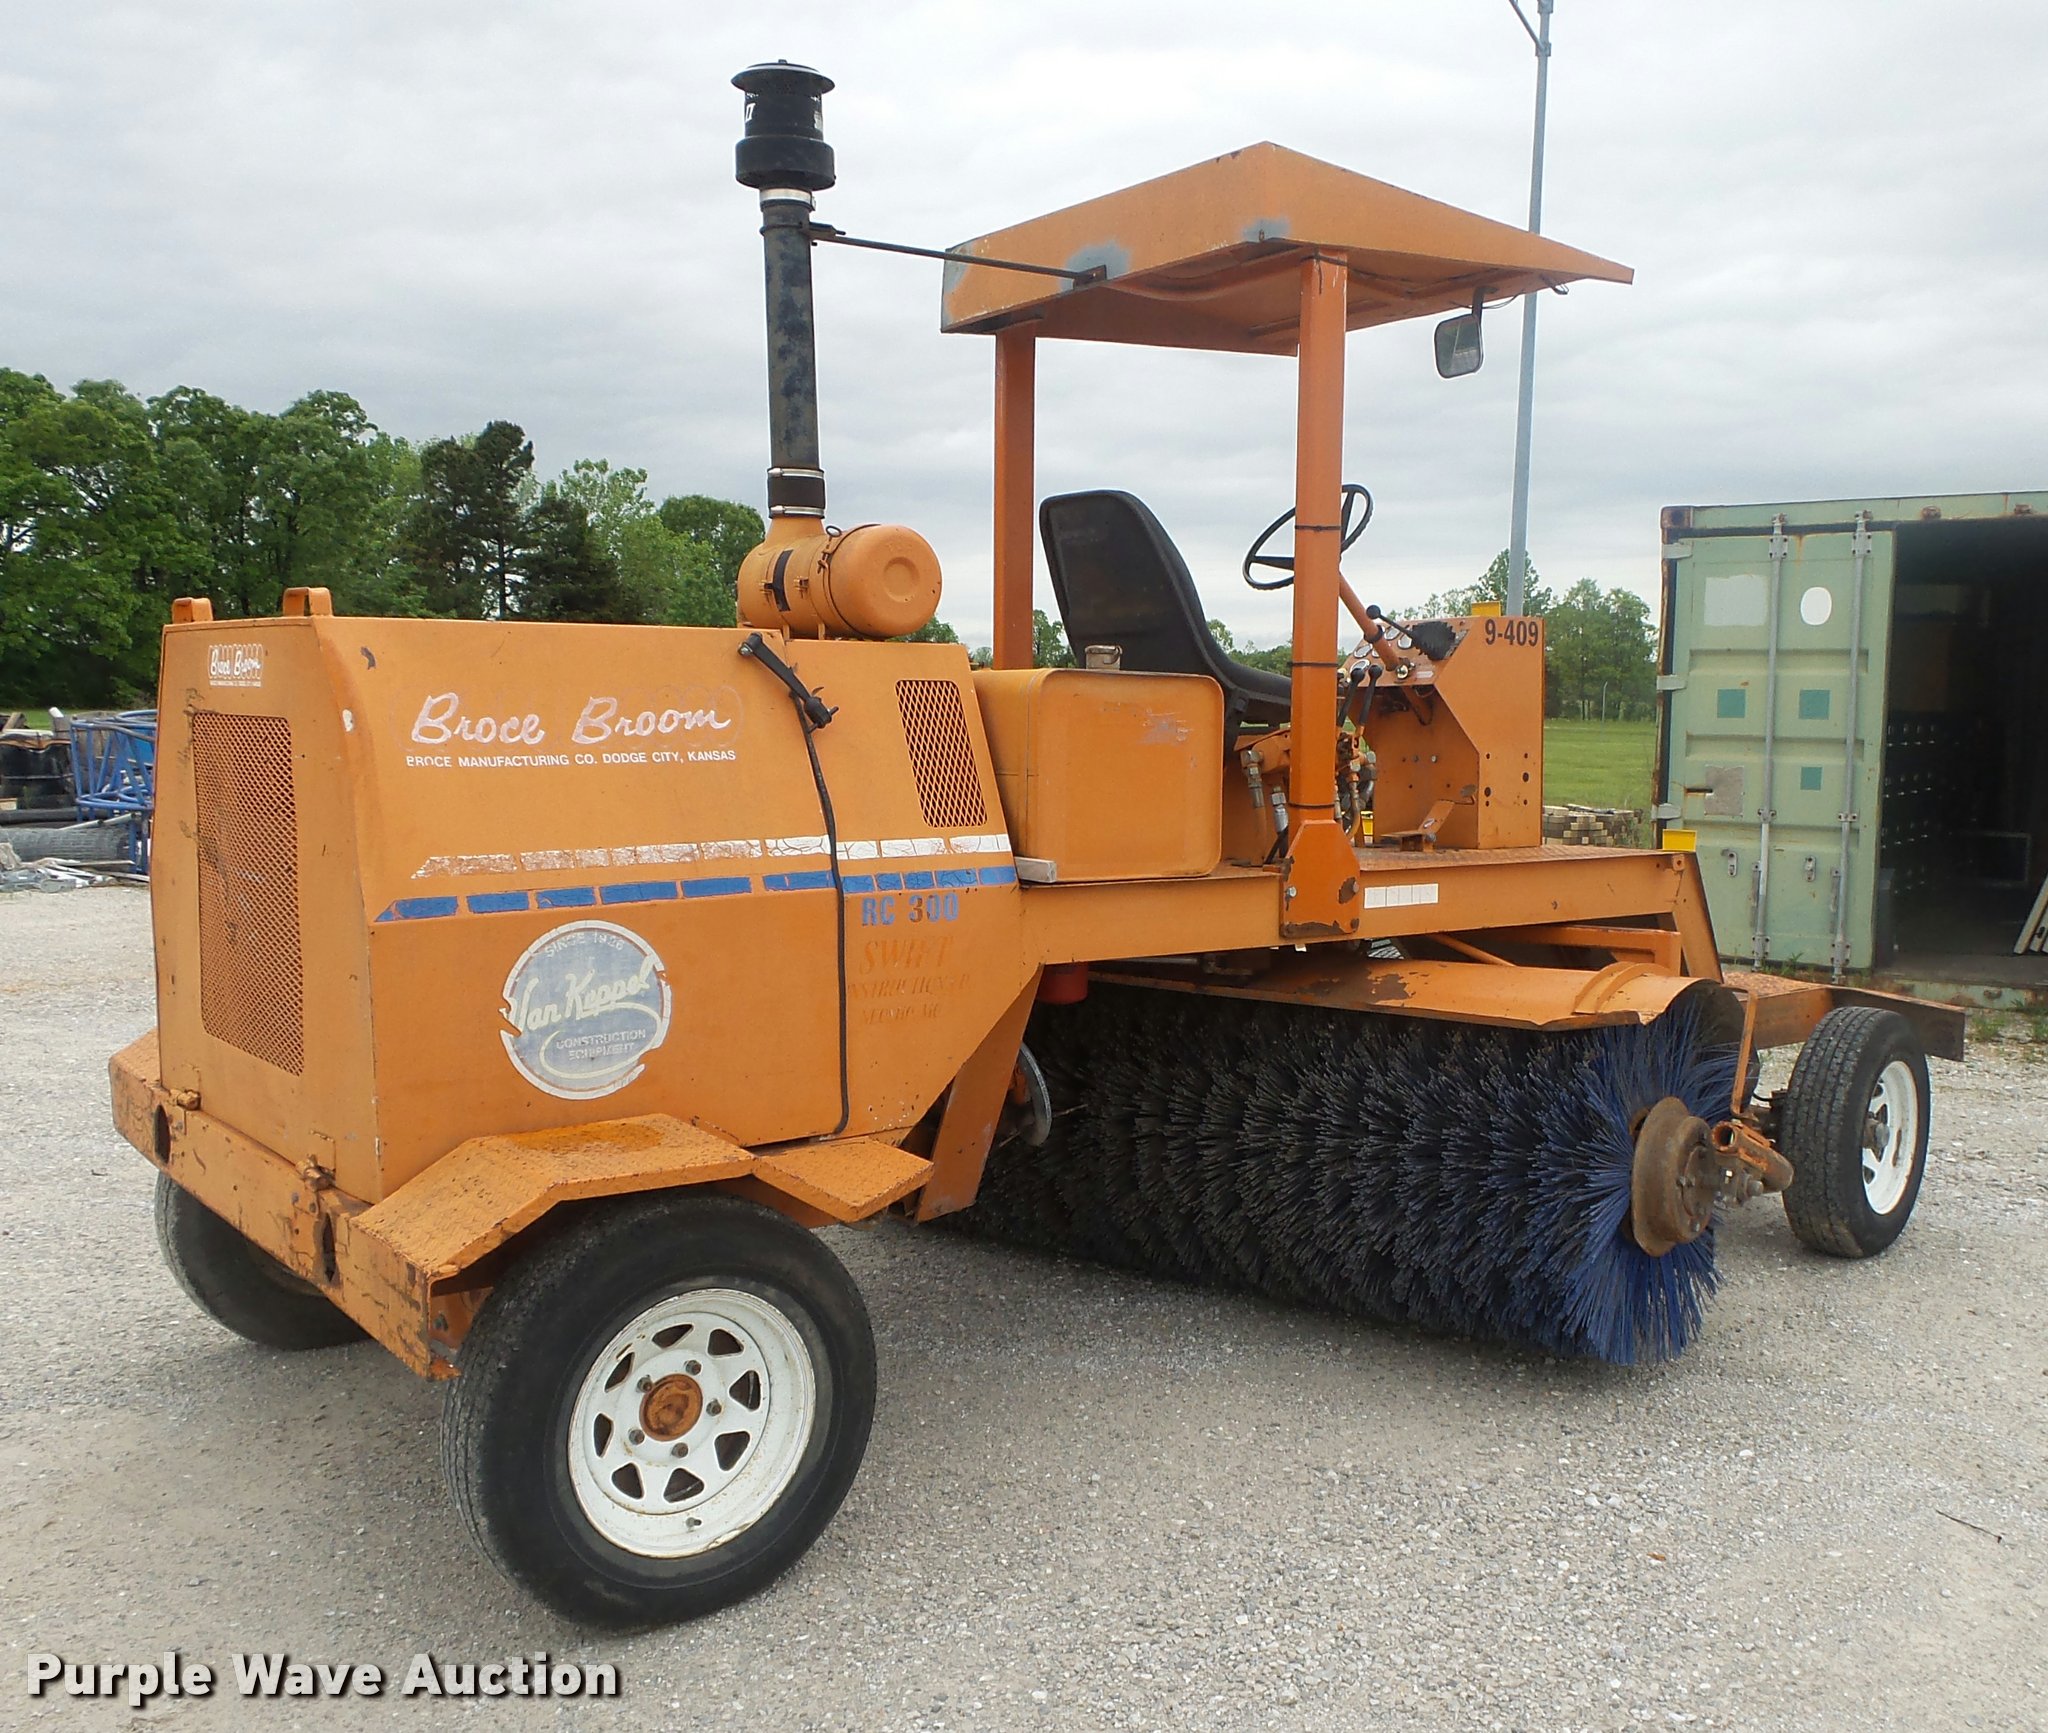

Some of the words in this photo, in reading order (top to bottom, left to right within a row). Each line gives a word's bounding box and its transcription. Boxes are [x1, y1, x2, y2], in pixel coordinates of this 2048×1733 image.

[1485, 618, 1538, 647] 9-409
[411, 692, 546, 744] Broce
[571, 696, 732, 744] Broom
[406, 755, 452, 767] BROCE
[458, 754, 569, 768] MANUFACTURING
[575, 753, 598, 765] CO.
[602, 752, 647, 764] DODGE
[652, 751, 684, 764] CITY,
[687, 750, 736, 762] KANSAS
[861, 896, 895, 926] RC
[908, 893, 960, 923] 300
[556, 1029, 646, 1049] CONSTRUCTION
